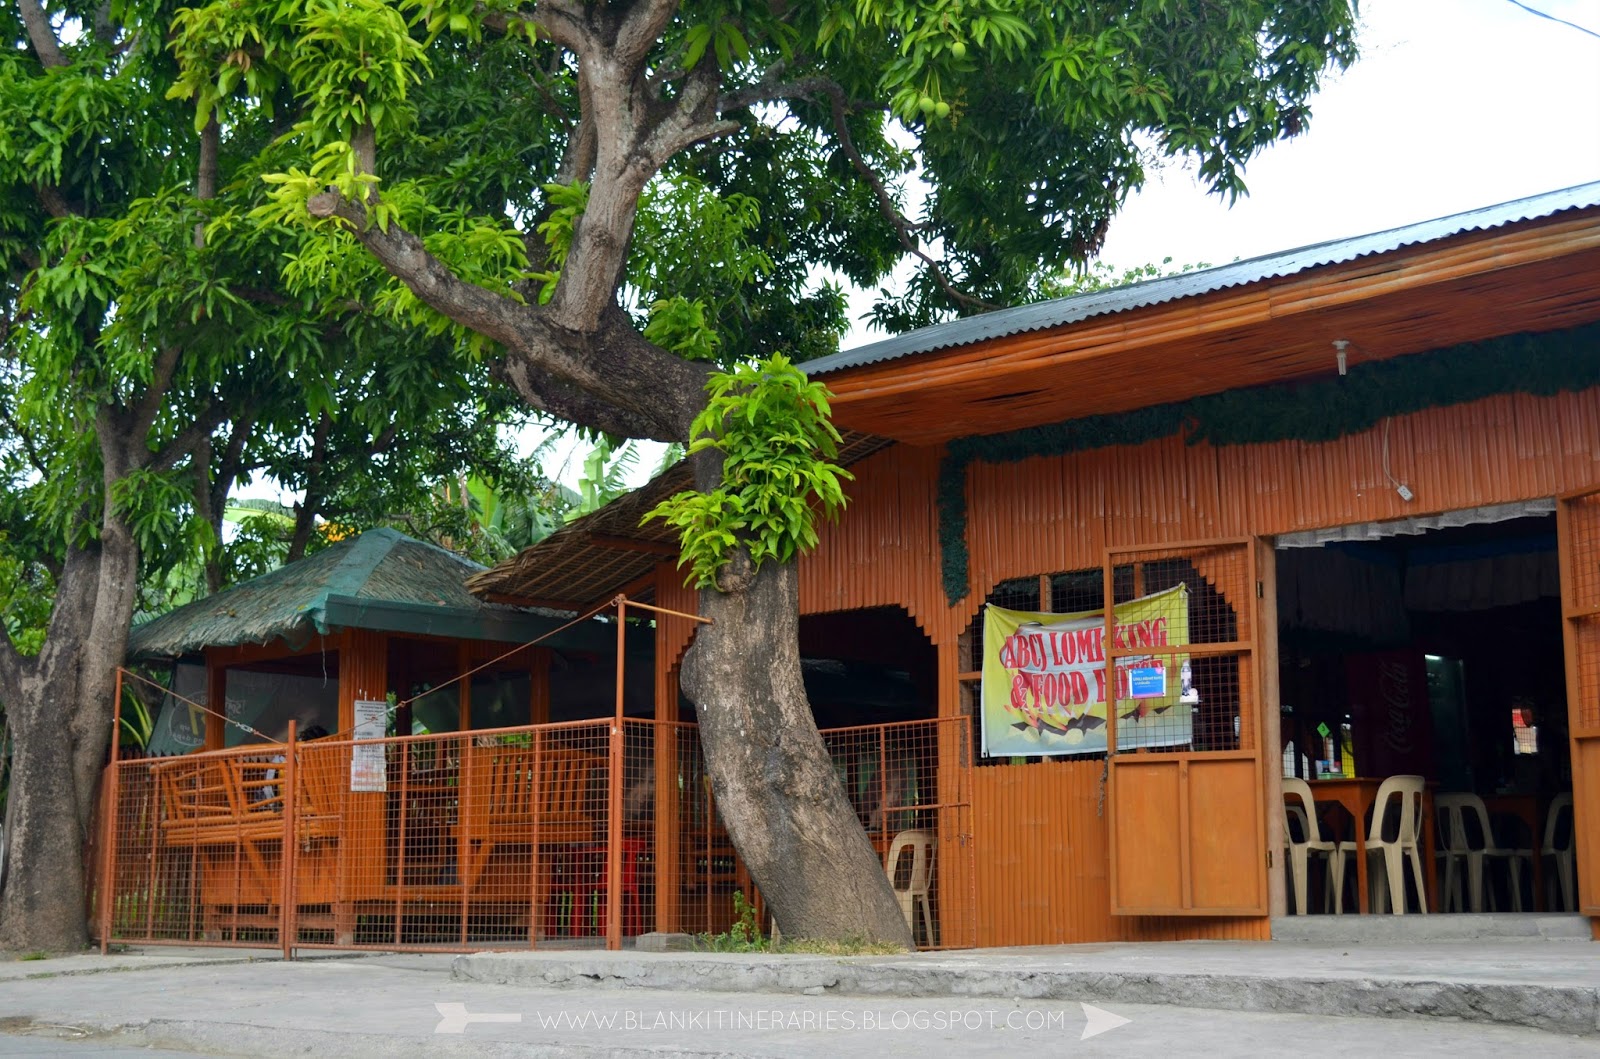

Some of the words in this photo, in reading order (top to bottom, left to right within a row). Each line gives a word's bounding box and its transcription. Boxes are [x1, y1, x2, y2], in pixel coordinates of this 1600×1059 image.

[1004, 633, 1047, 672] ABCJ
[1049, 628, 1105, 666] LOMI
[1113, 616, 1168, 648] KING
[1031, 671, 1089, 708] FOOD
